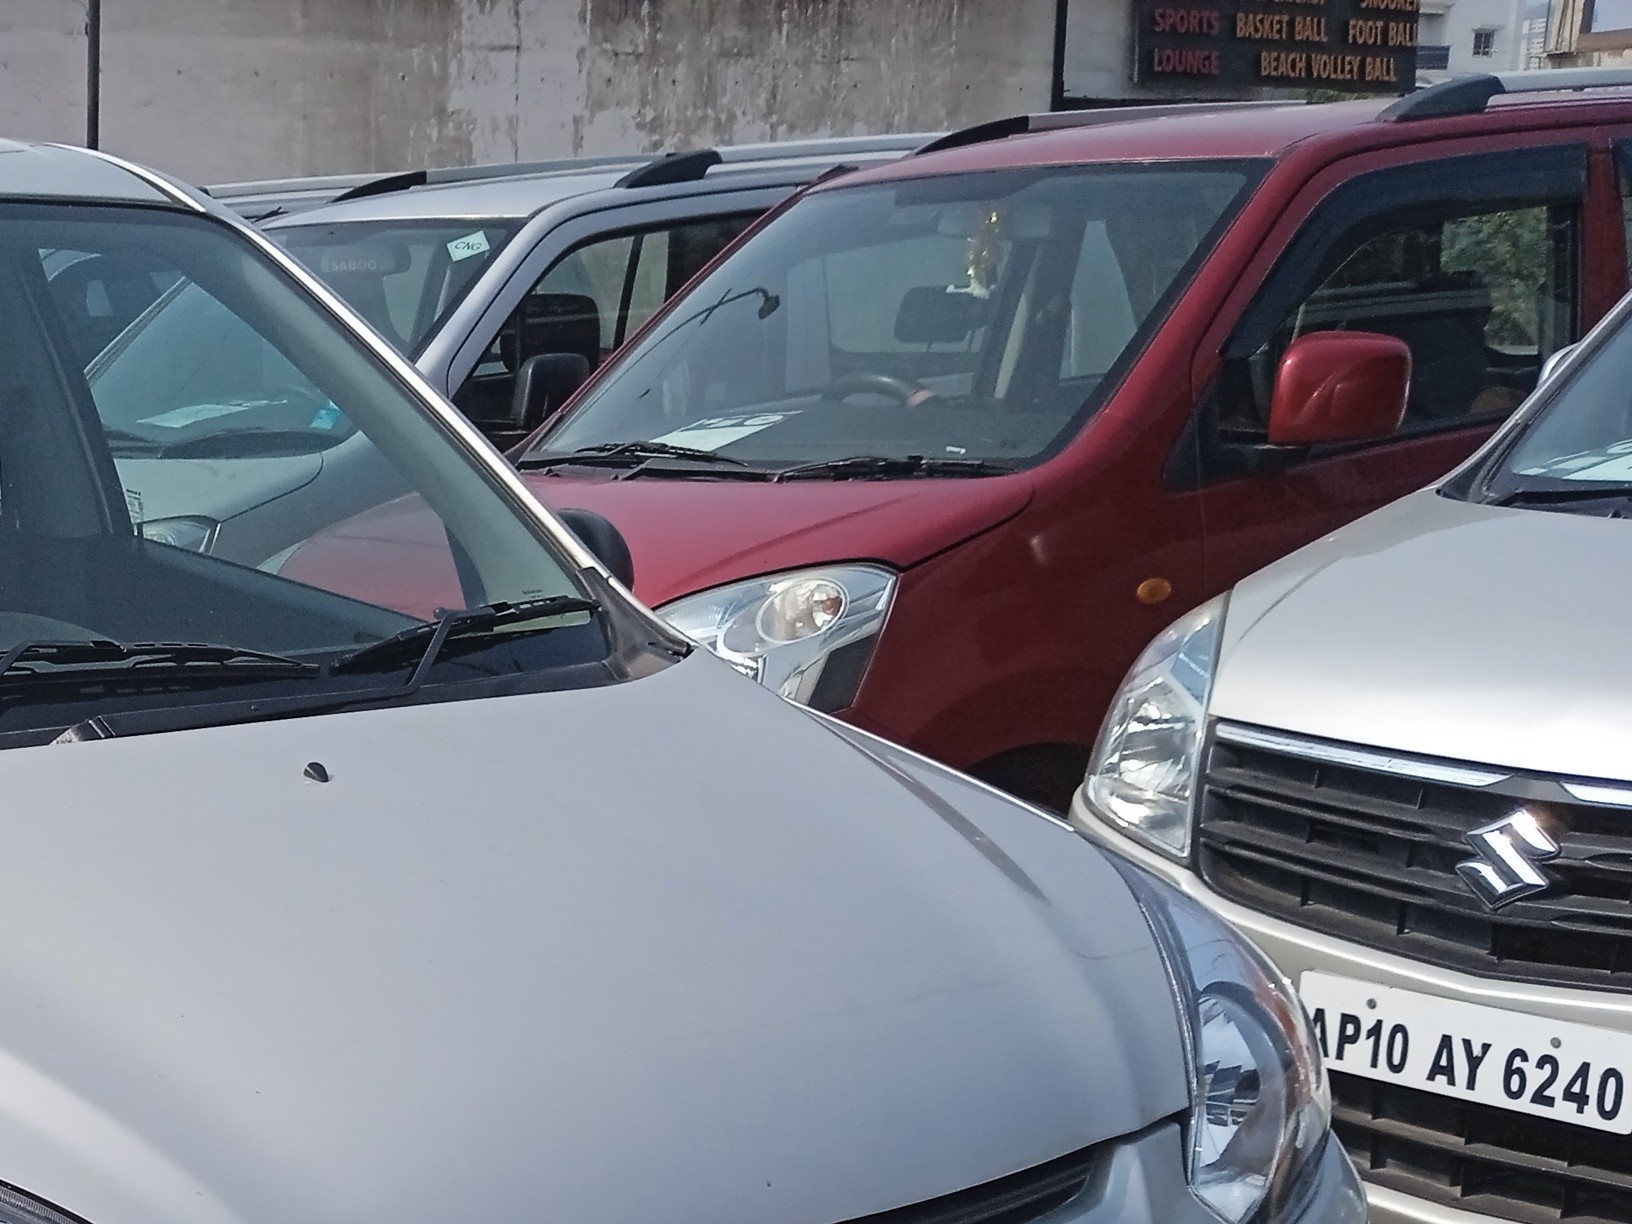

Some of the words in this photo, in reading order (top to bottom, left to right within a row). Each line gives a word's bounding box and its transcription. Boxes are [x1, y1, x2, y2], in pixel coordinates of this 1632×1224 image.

[1154, 8, 1220, 34] SPORTS
[1236, 12, 1289, 40] BASKET
[1294, 15, 1329, 43] BALL
[1348, 18, 1385, 46] FOOT
[1388, 21, 1419, 48] BALL
[1153, 48, 1220, 75] LOUNGE
[1260, 51, 1306, 79] BEACH
[1312, 53, 1361, 81] VOLLEY
[1365, 55, 1397, 83] BALL
[1312, 1007, 1410, 1074] AP10
[1426, 1033, 1493, 1092] AY
[1502, 1047, 1625, 1122] 6240
